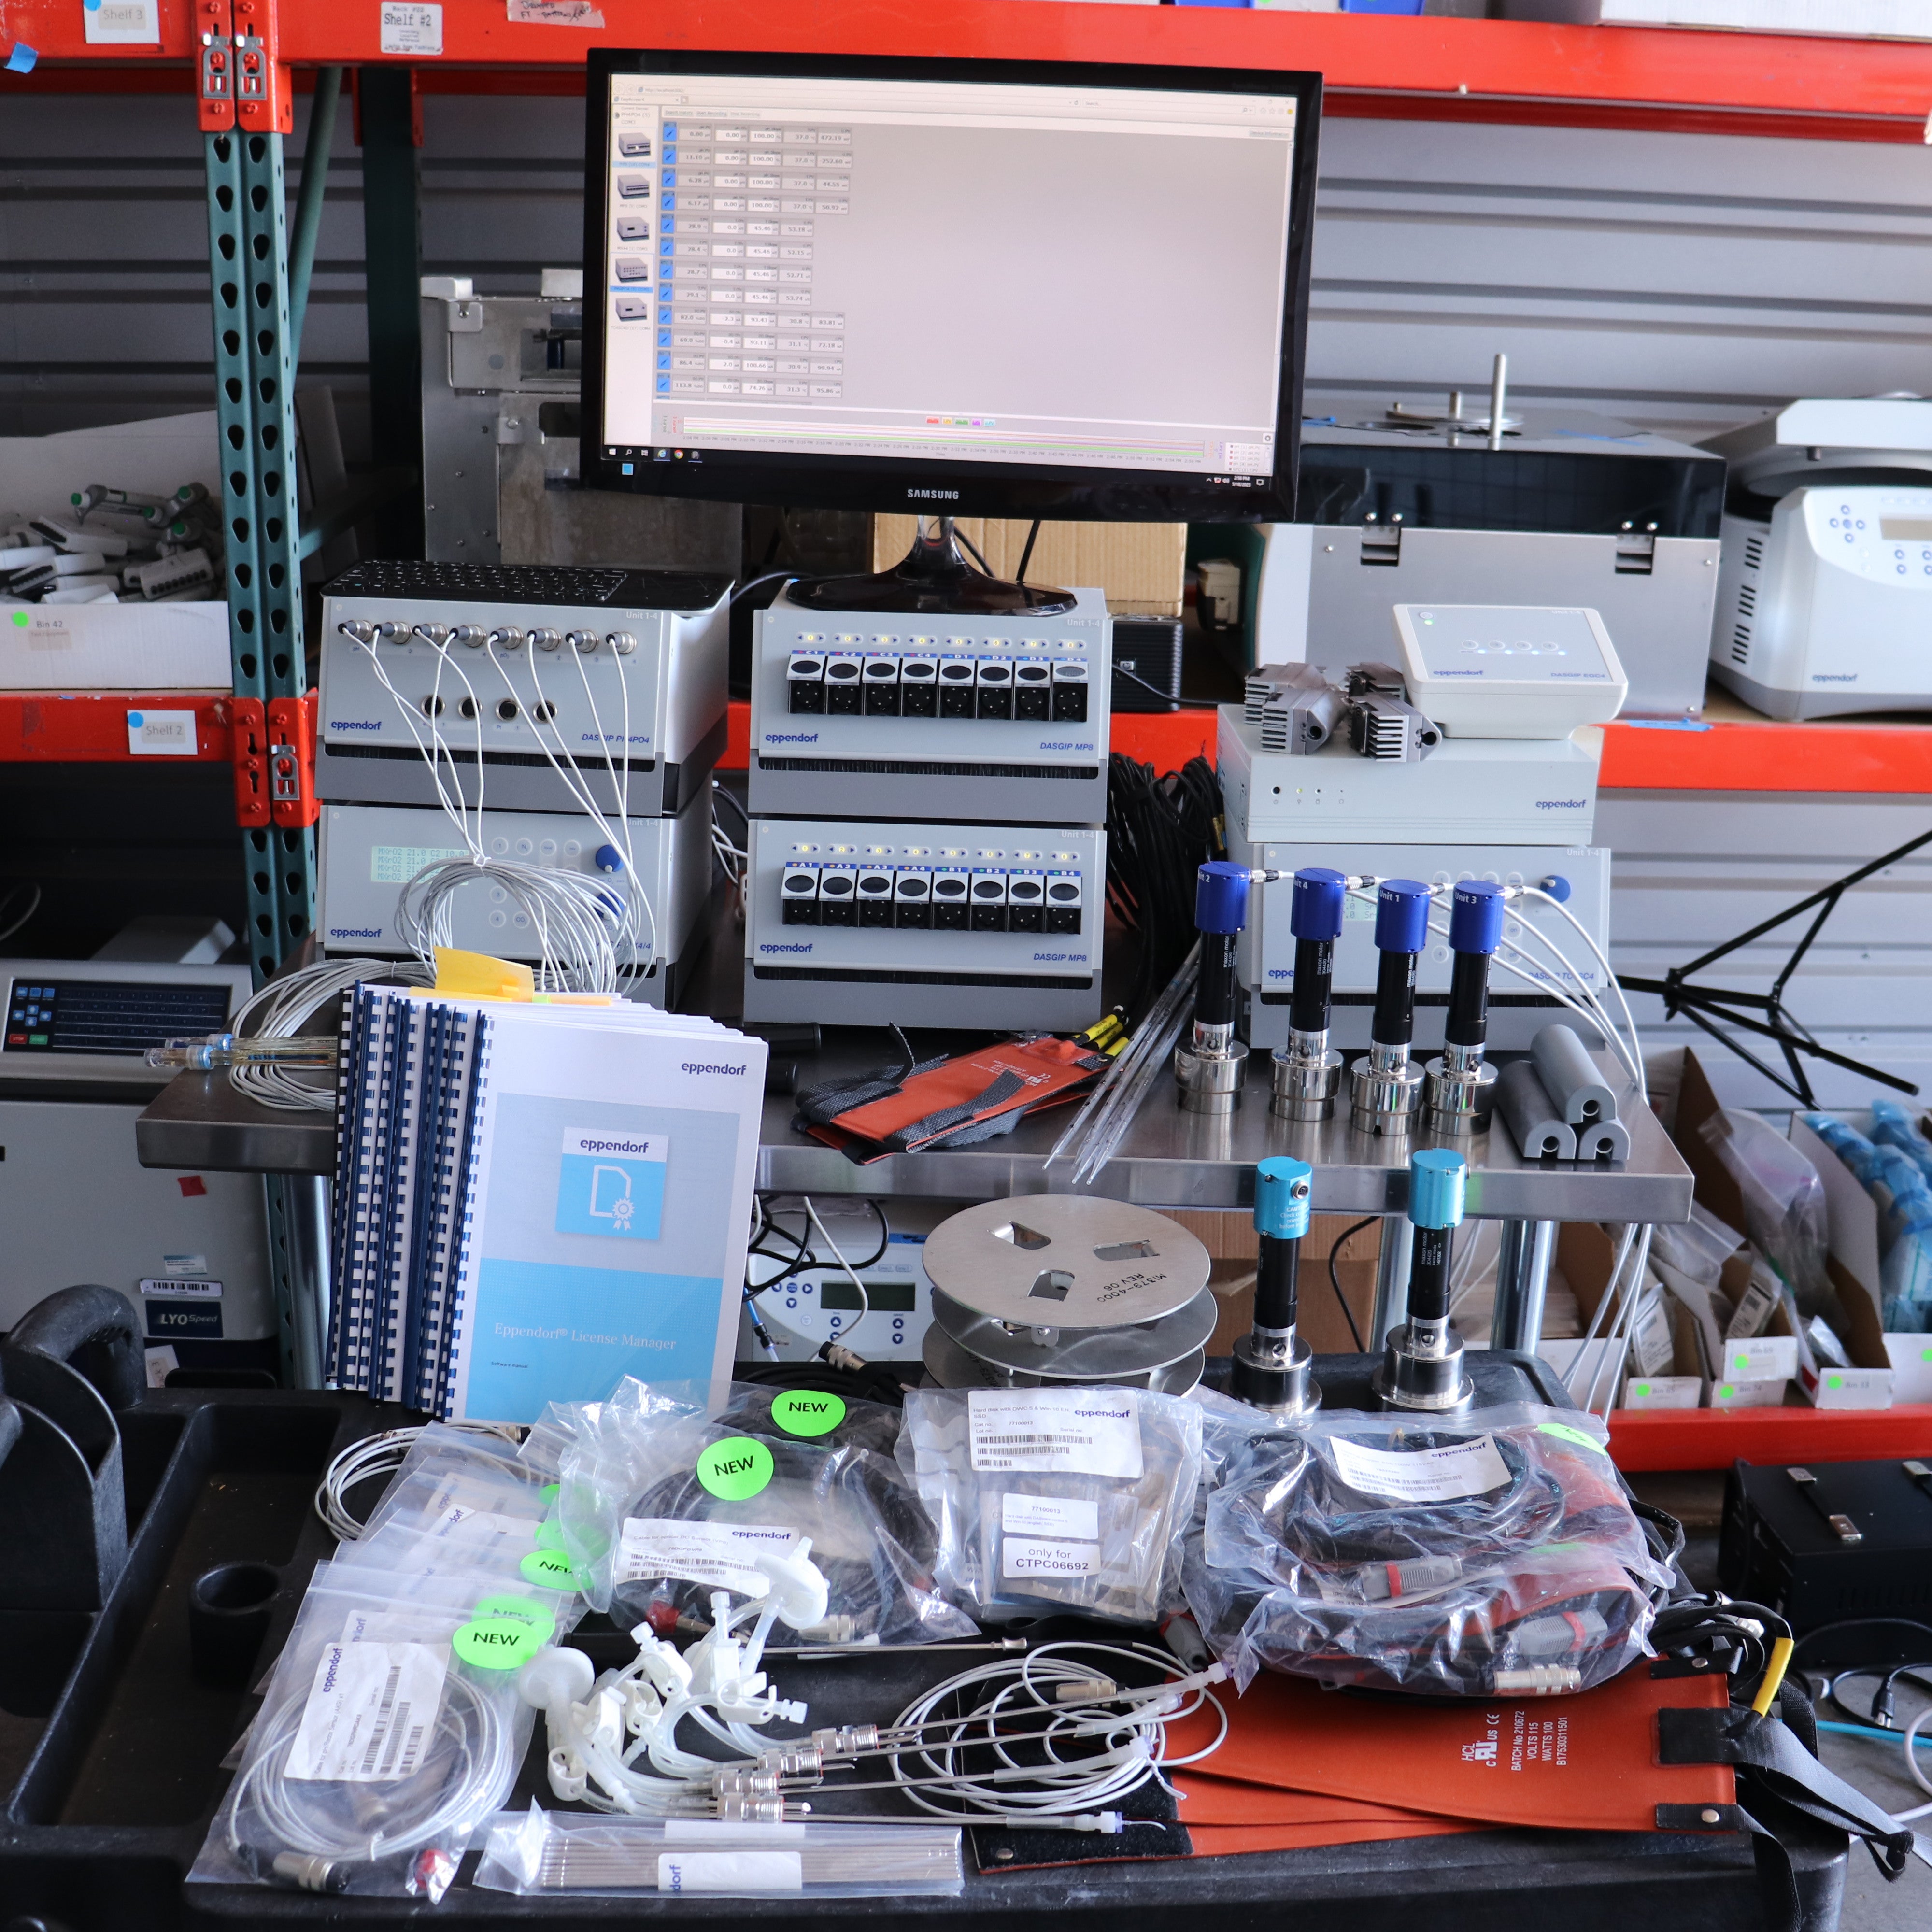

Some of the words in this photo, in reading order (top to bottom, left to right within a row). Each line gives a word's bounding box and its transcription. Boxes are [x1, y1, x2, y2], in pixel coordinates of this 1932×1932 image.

[104, 9, 131, 19] Shelf
[137, 10, 142, 19] 3
[385, 13, 413, 25] Shelf
[421, 15, 431, 26] #2
[907, 489, 959, 500] SAMSUNG
[1812, 673, 1858, 682] eppendorf
[146, 726, 173, 735] Shelf
[176, 726, 182, 735] 2
[331, 721, 381, 730] eppendorf
[766, 732, 818, 744] eppendorf
[1040, 742, 1073, 750] DASGIP
[1536, 799, 1586, 810] eppendorf
[1379, 890, 1393, 901] Unit
[1455, 892, 1469, 903] Unit
[331, 928, 382, 938] eppendorf
[760, 943, 813, 954] eppendorf
[1034, 953, 1066, 962] DASGIP
[1069, 954, 1087, 962] MP8
[682, 1061, 747, 1076] eppendorf
[580, 1137, 649, 1154] eppendorf
[1121, 1273, 1144, 1284] REV
[572, 1330, 618, 1345] License
[622, 1334, 676, 1351] Manager
[788, 1401, 829, 1413] NEW
[1075, 1409, 1130, 1418] eppendorf
[1432, 1442, 1487, 1458] eppendorf
[714, 1455, 754, 1477] NEW
[732, 1530, 791, 1540] eppendorf
[1029, 1548, 1052, 1559] only
[1056, 1550, 1071, 1559] for
[1016, 1559, 1089, 1570] CTPC06692
[473, 1632, 520, 1646] NEW
[323, 1648, 343, 1692] eppendorf
[1514, 1711, 1524, 1734] 210672
[1529, 1722, 1538, 1734] 115
[1543, 1722, 1553, 1733] 100
[1513, 1735, 1523, 1745] No
[1462, 1743, 1475, 1761] HCL
[1527, 1736, 1537, 1760] VOLTS
[1542, 1736, 1552, 1761] WATTS
[1511, 1746, 1522, 1771] BATCH
